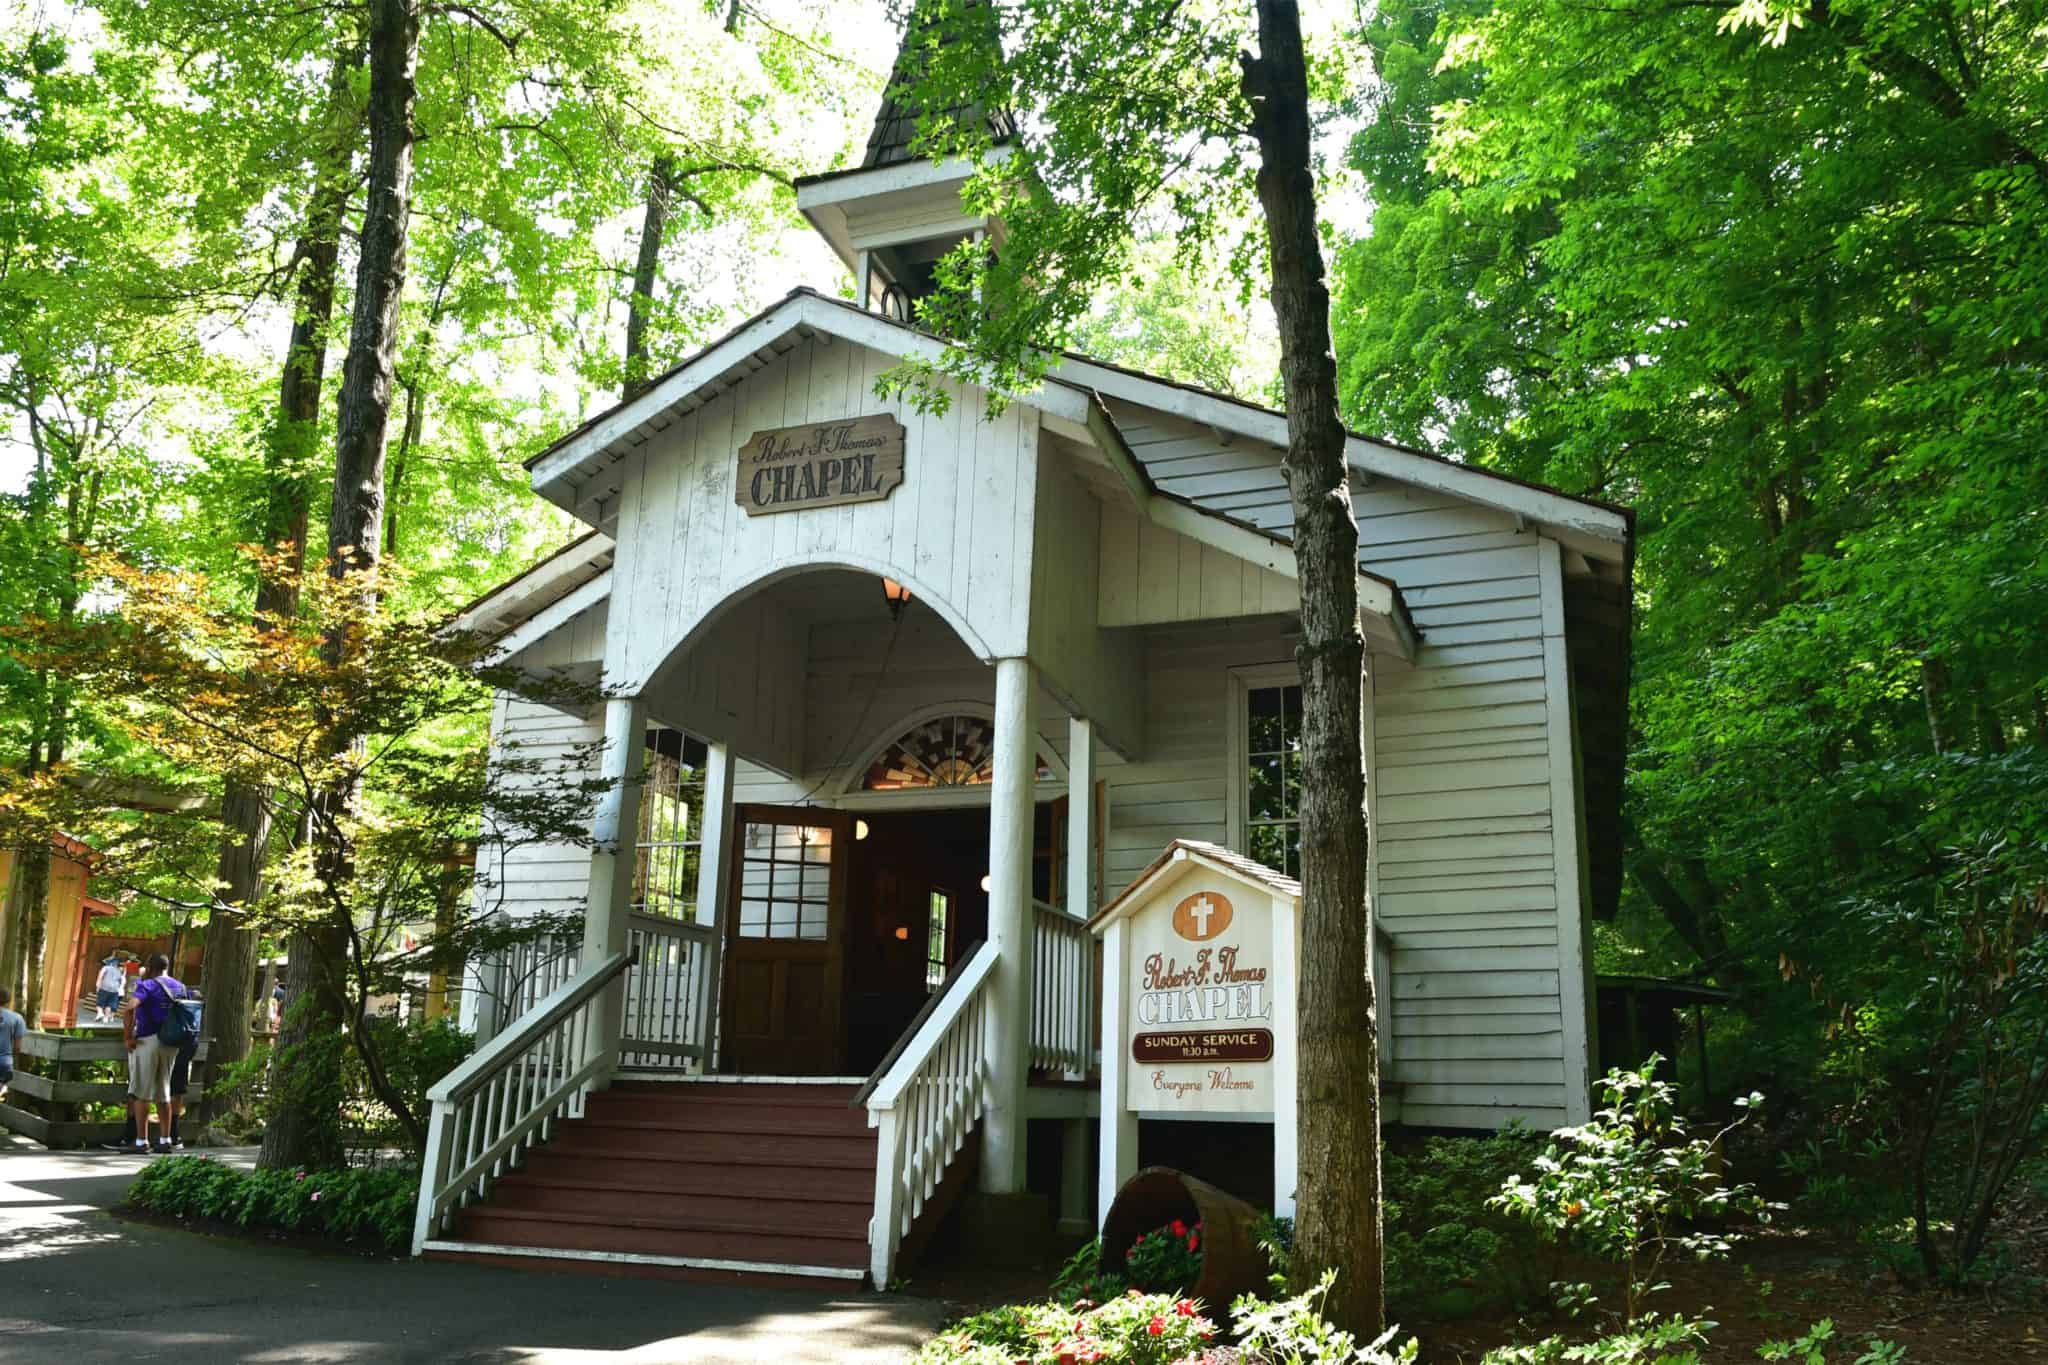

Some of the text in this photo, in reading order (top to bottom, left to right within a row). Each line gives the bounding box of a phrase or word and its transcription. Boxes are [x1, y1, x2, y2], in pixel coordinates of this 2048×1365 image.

[752, 435, 807, 463] Robert
[825, 424, 887, 453] Thomas
[751, 453, 884, 506] CHAPEL
[1143, 944, 1267, 989] Robert F. Thomas
[1138, 983, 1272, 1024] CHAPEL
[1145, 1034, 1257, 1048] SUNDAY SERVICE
[1182, 1047, 1202, 1057] 11:30
[1151, 1066, 1255, 1099] Everyone Welcome
